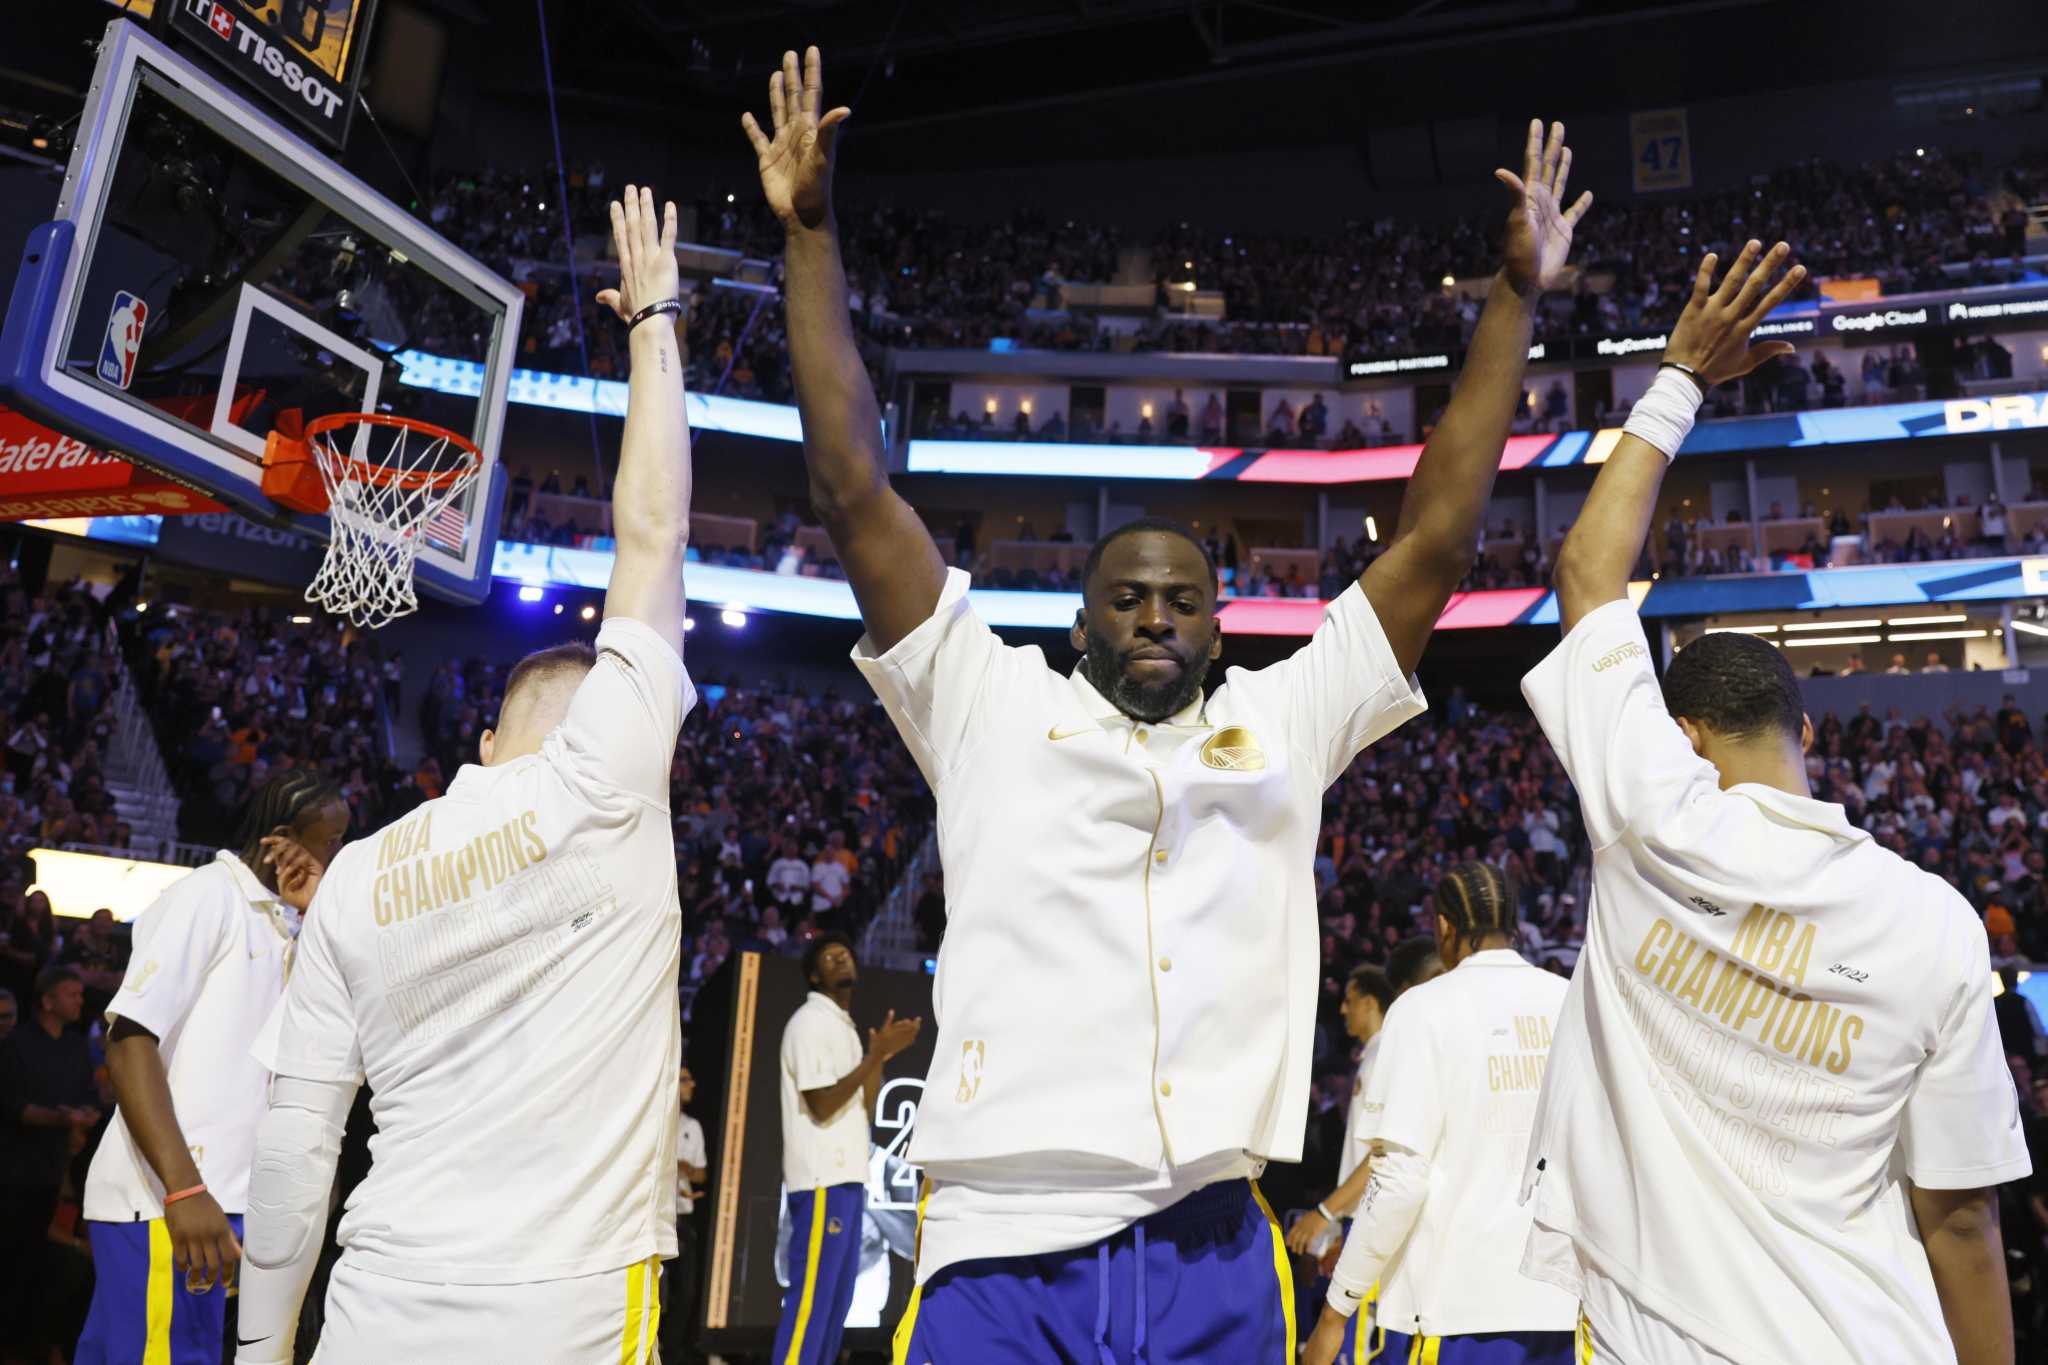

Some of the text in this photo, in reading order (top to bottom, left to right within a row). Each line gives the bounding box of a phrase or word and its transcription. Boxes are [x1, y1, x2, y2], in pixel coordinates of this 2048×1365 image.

[235, 21, 343, 119] TISSOT
[1641, 136, 1682, 171] 47
[1833, 309, 1927, 331] Google Cloud
[373, 810, 548, 927] CHAMPIONS
[376, 809, 432, 871] NBA
[1731, 903, 1818, 987] NBA
[1828, 963, 1871, 983] 2022
[1513, 1016, 1552, 1049] NBA
[1635, 918, 1864, 1076] CHAMPIONS
[1729, 1049, 1856, 1147] STATE
